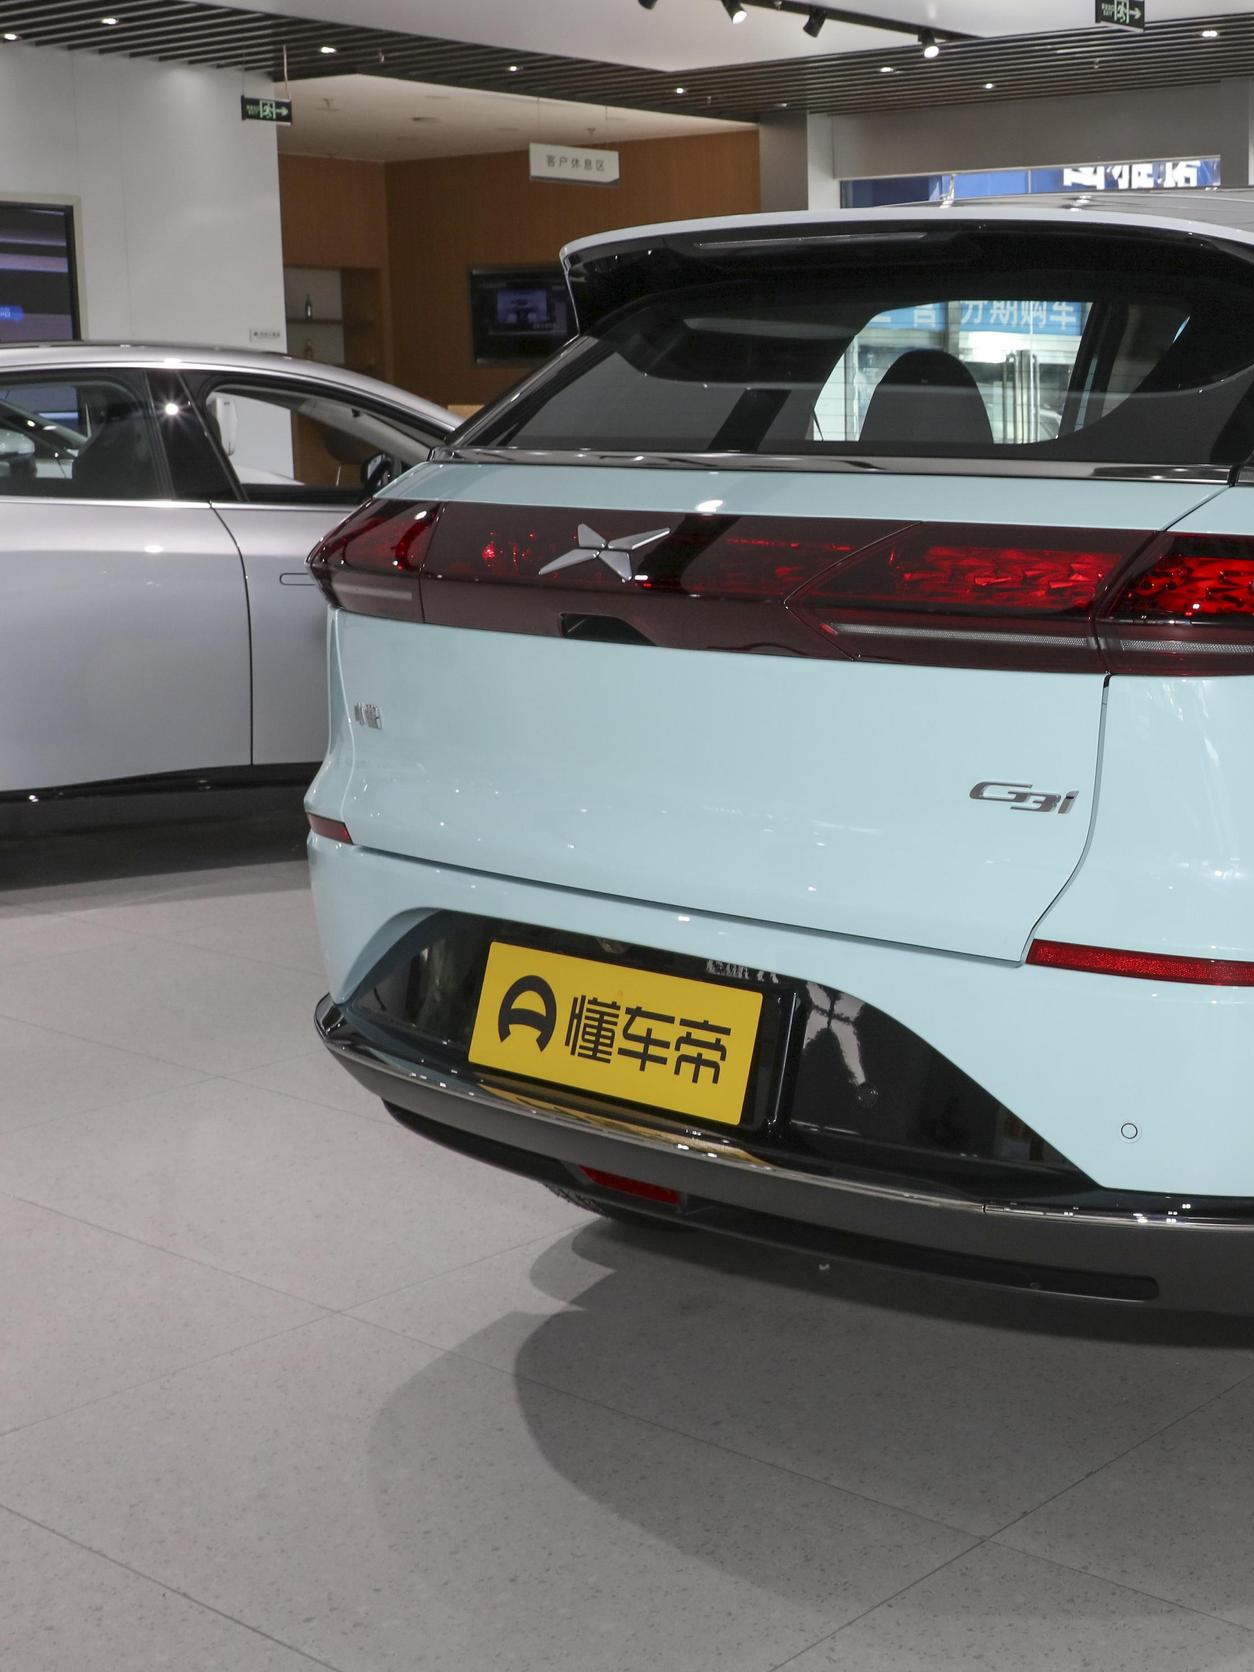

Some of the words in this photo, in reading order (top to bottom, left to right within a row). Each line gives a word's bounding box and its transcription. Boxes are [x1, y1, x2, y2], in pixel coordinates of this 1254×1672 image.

[968, 780, 1080, 815] G3i
[564, 994, 732, 1085] 懂车帝
